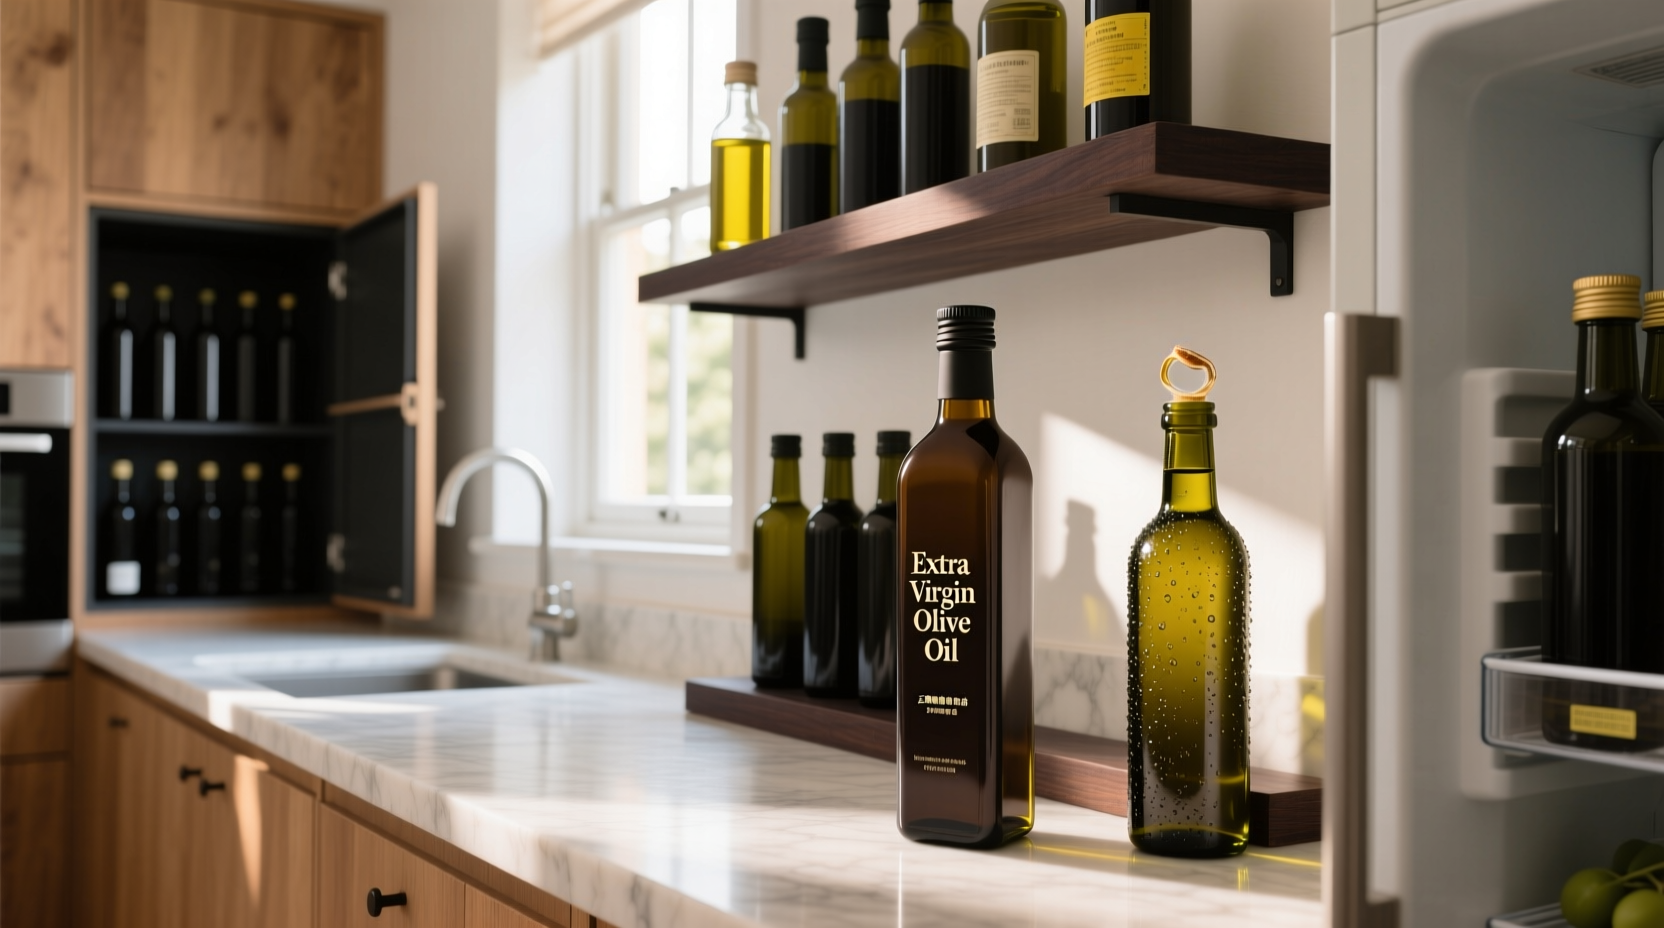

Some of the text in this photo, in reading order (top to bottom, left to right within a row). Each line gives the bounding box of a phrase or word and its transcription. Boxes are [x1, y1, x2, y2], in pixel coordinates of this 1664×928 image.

[911, 551, 971, 575] Extra
[909, 580, 976, 610] Virgin
[913, 608, 971, 634] Olive
[924, 637, 959, 662] Oil
